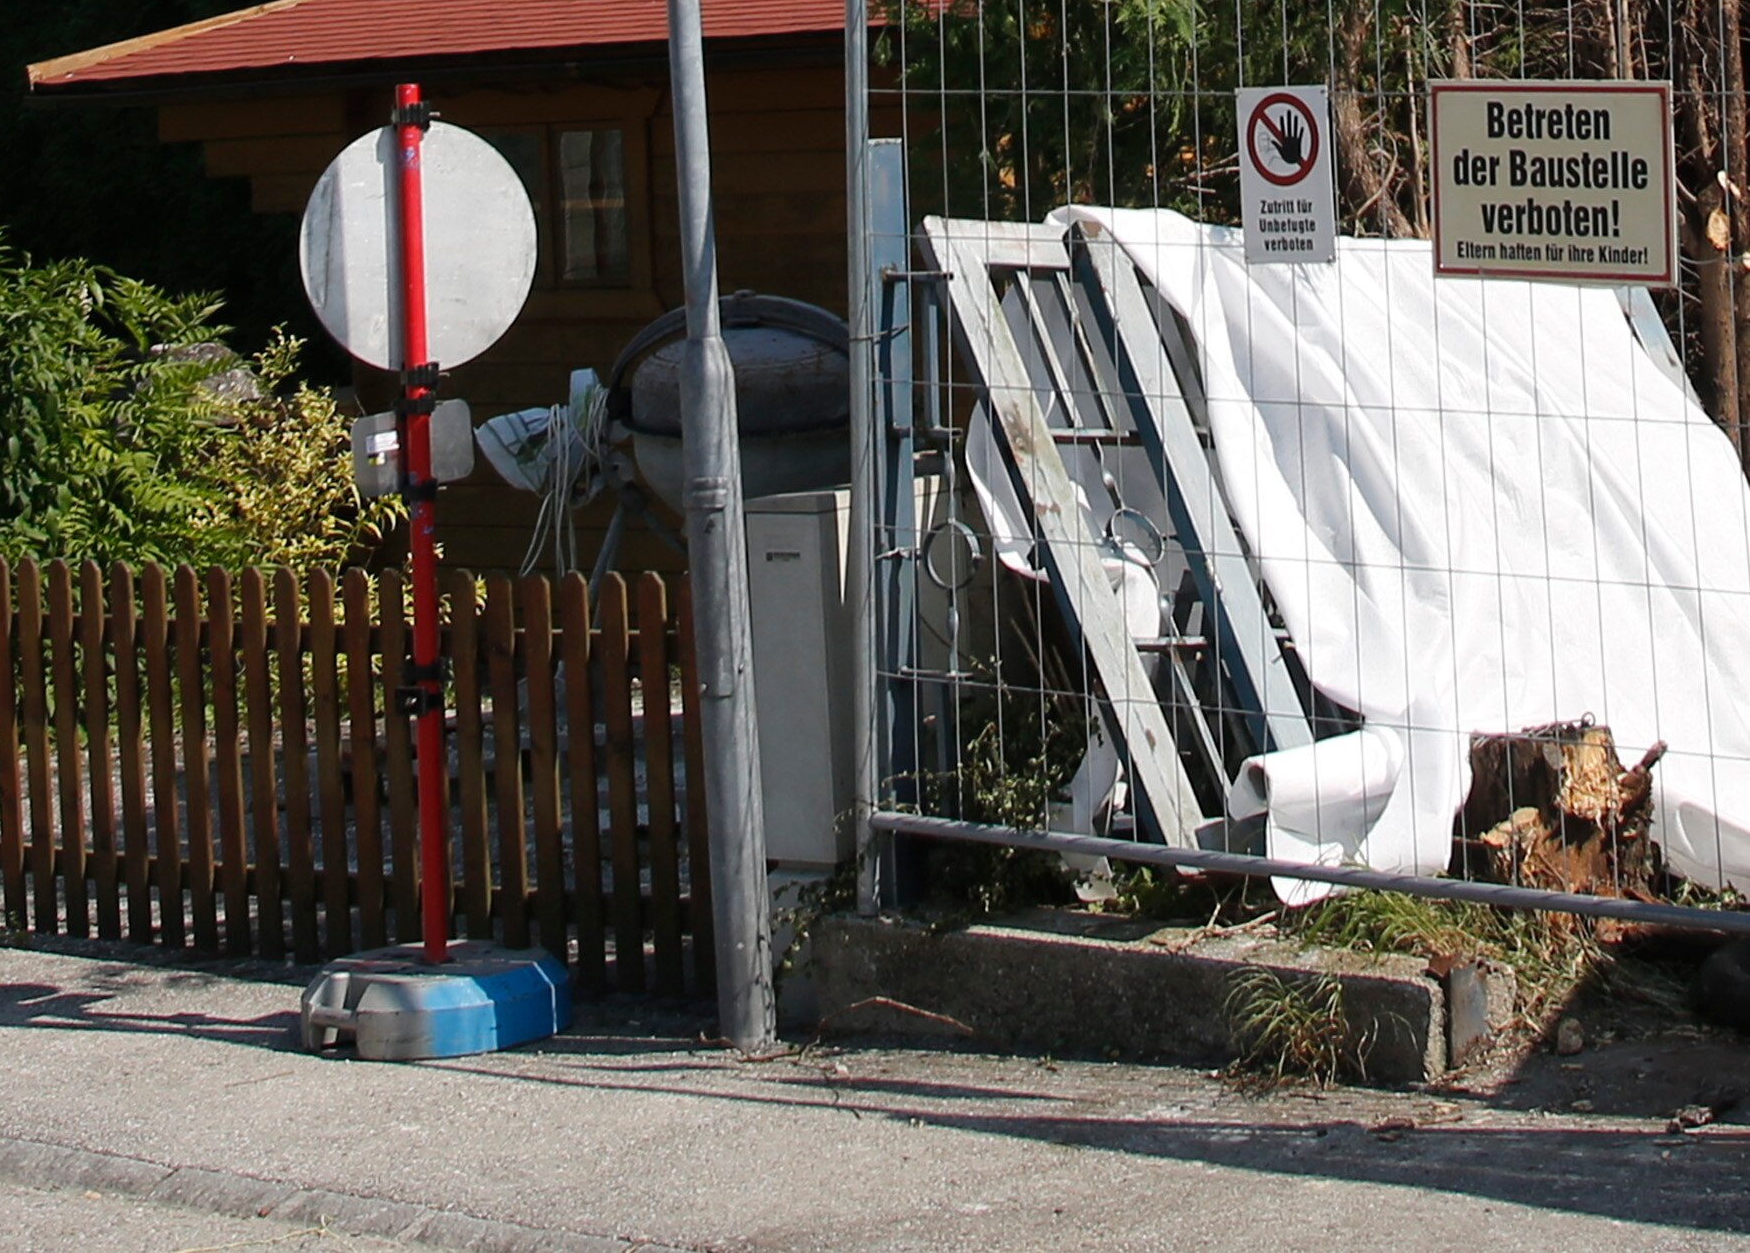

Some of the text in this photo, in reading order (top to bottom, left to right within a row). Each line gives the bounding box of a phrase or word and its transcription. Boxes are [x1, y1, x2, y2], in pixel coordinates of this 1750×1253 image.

[1487, 102, 1611, 140] Betreten
[1454, 149, 1648, 189] der Baustelle
[1260, 199, 1312, 214] Zutritt für
[1481, 198, 1620, 237] verboten!
[1259, 219, 1315, 234] Unbefugte
[1264, 237, 1313, 251] verboten
[1457, 241, 1648, 264] Eltern haften für ihre Kinder!
